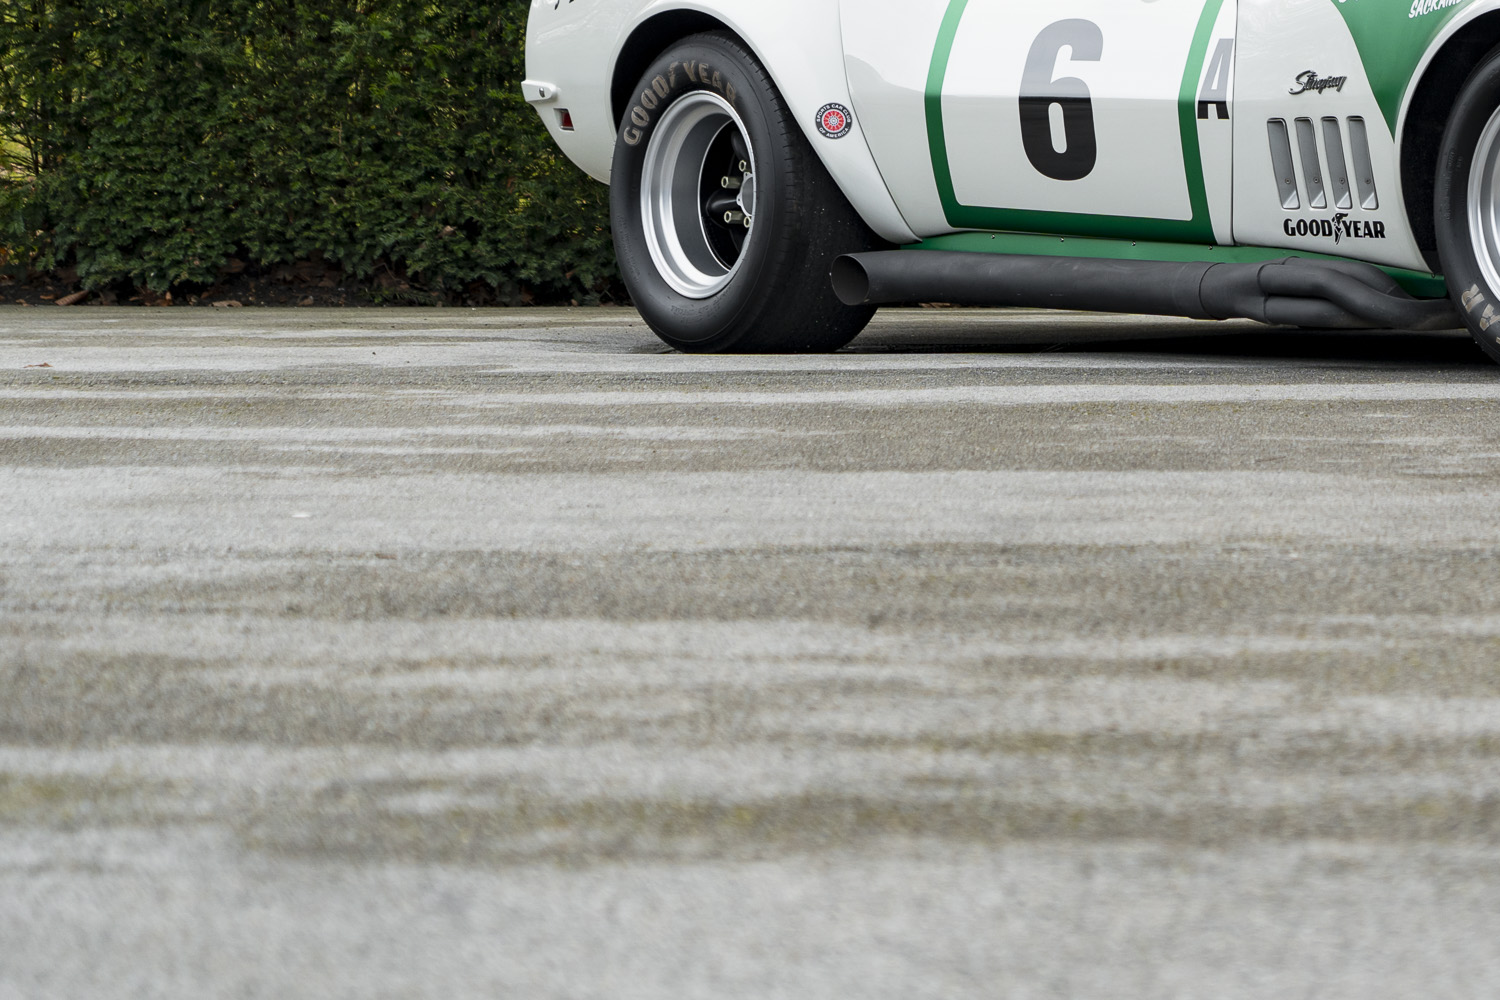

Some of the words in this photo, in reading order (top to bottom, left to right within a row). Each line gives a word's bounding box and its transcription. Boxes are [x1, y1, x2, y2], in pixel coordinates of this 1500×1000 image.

[623, 60, 738, 146] GOODYEAR
[1018, 18, 1104, 181] 6
[1197, 38, 1235, 120] A
[817, 105, 830, 121] SPORTS
[826, 128, 849, 138] AMERICA
[1283, 215, 1386, 242] GOODYEAR
